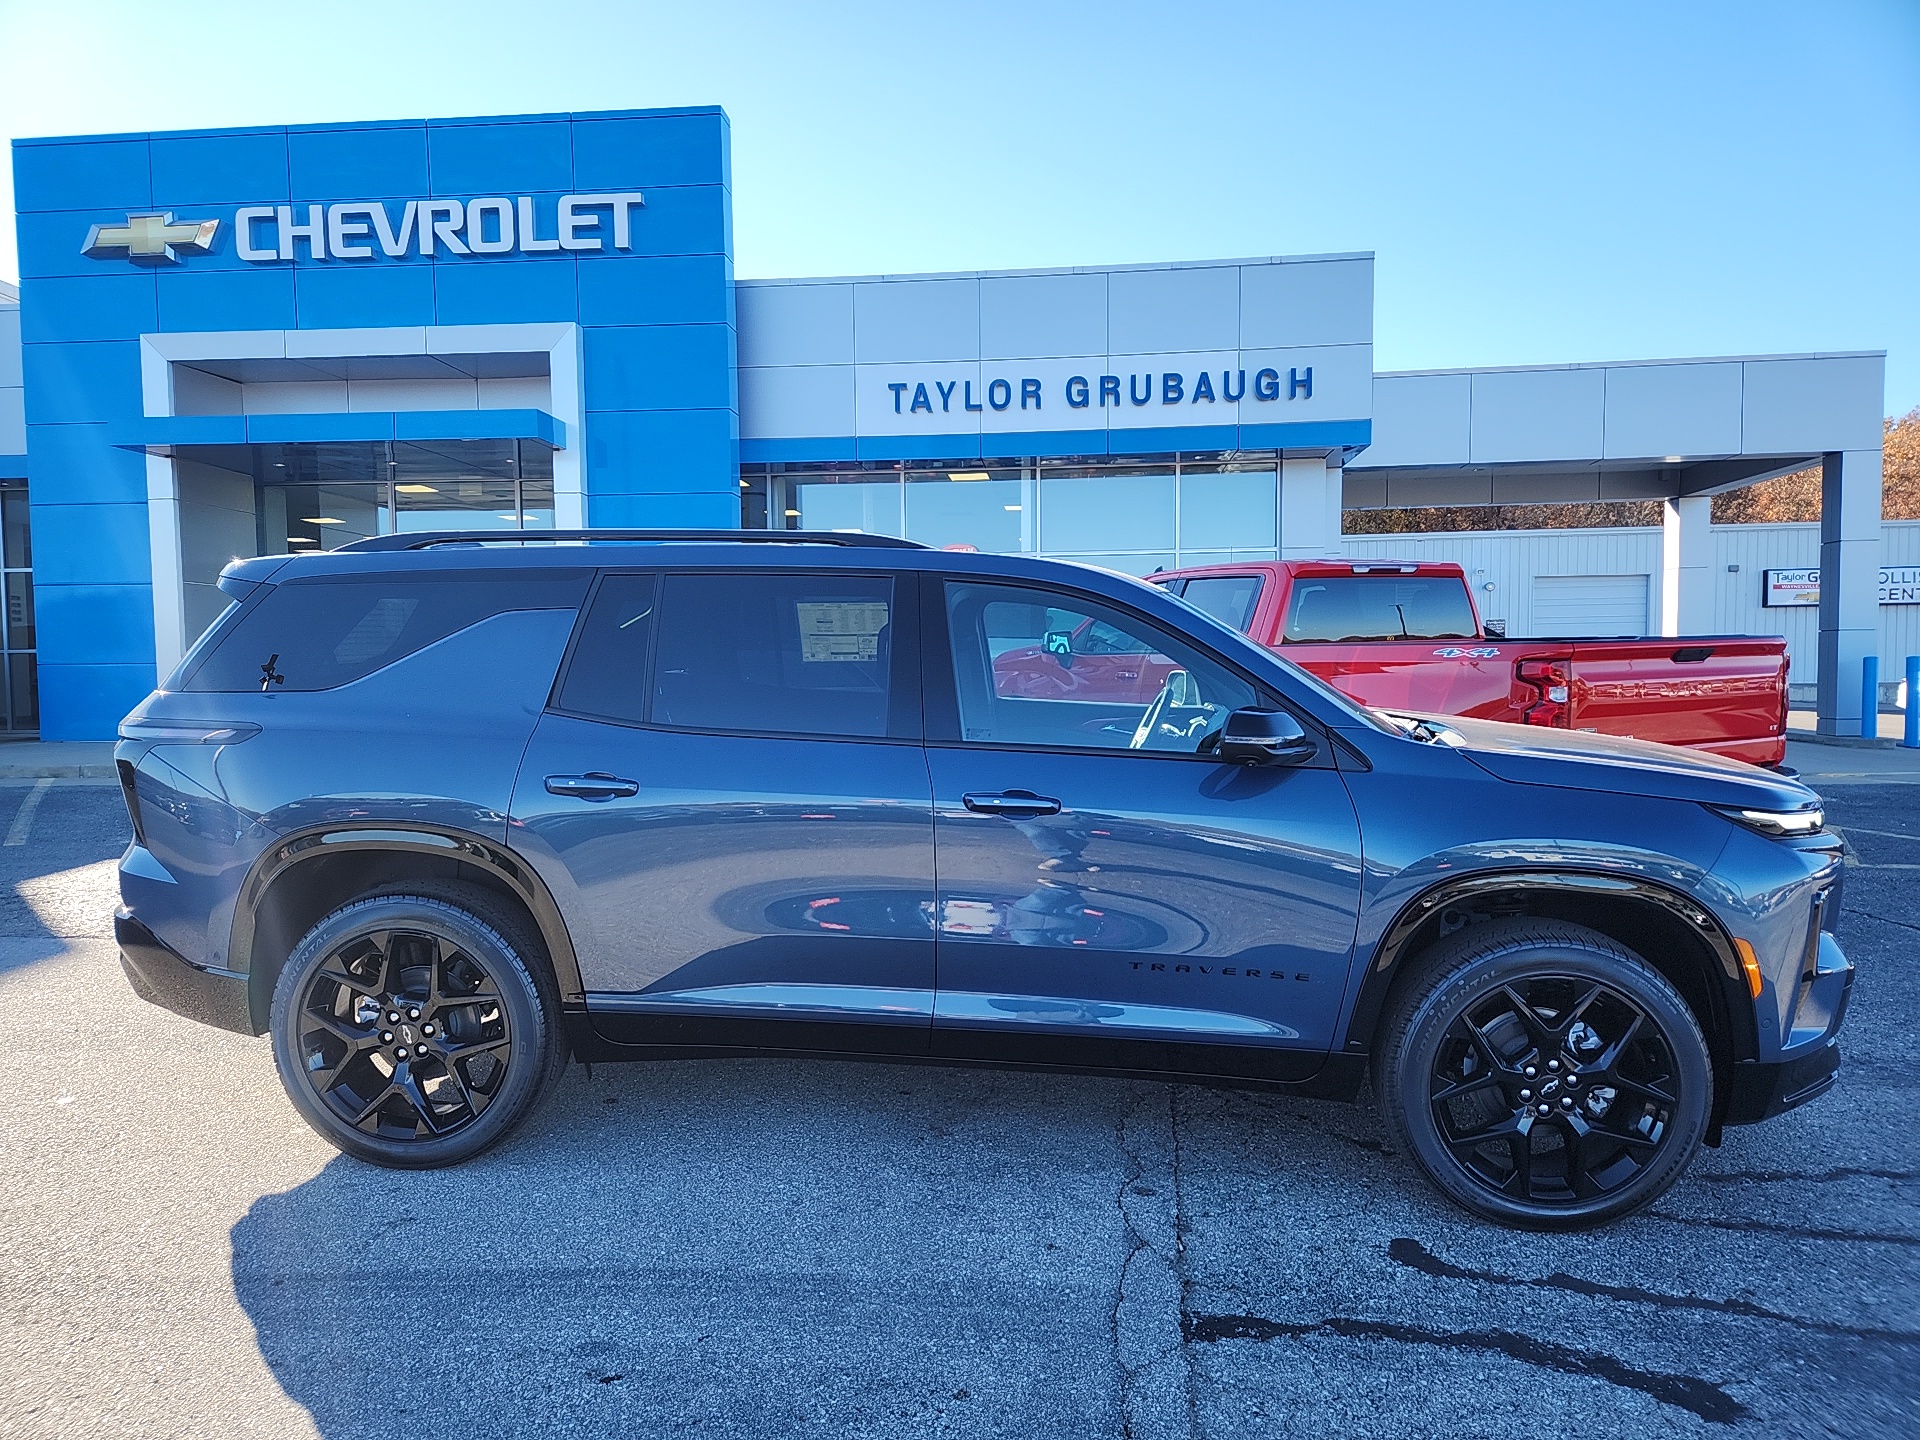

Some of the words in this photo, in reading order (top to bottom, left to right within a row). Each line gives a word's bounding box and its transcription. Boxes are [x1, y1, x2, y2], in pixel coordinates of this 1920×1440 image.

[235, 192, 644, 261] CHEVROLET
[888, 377, 1042, 414] TAYLOR
[1066, 366, 1313, 408] GRUBAUGH
[1773, 572, 1806, 583] Taylor
[1808, 571, 1820, 583] G
[1128, 961, 1310, 981] TRAVERSE
